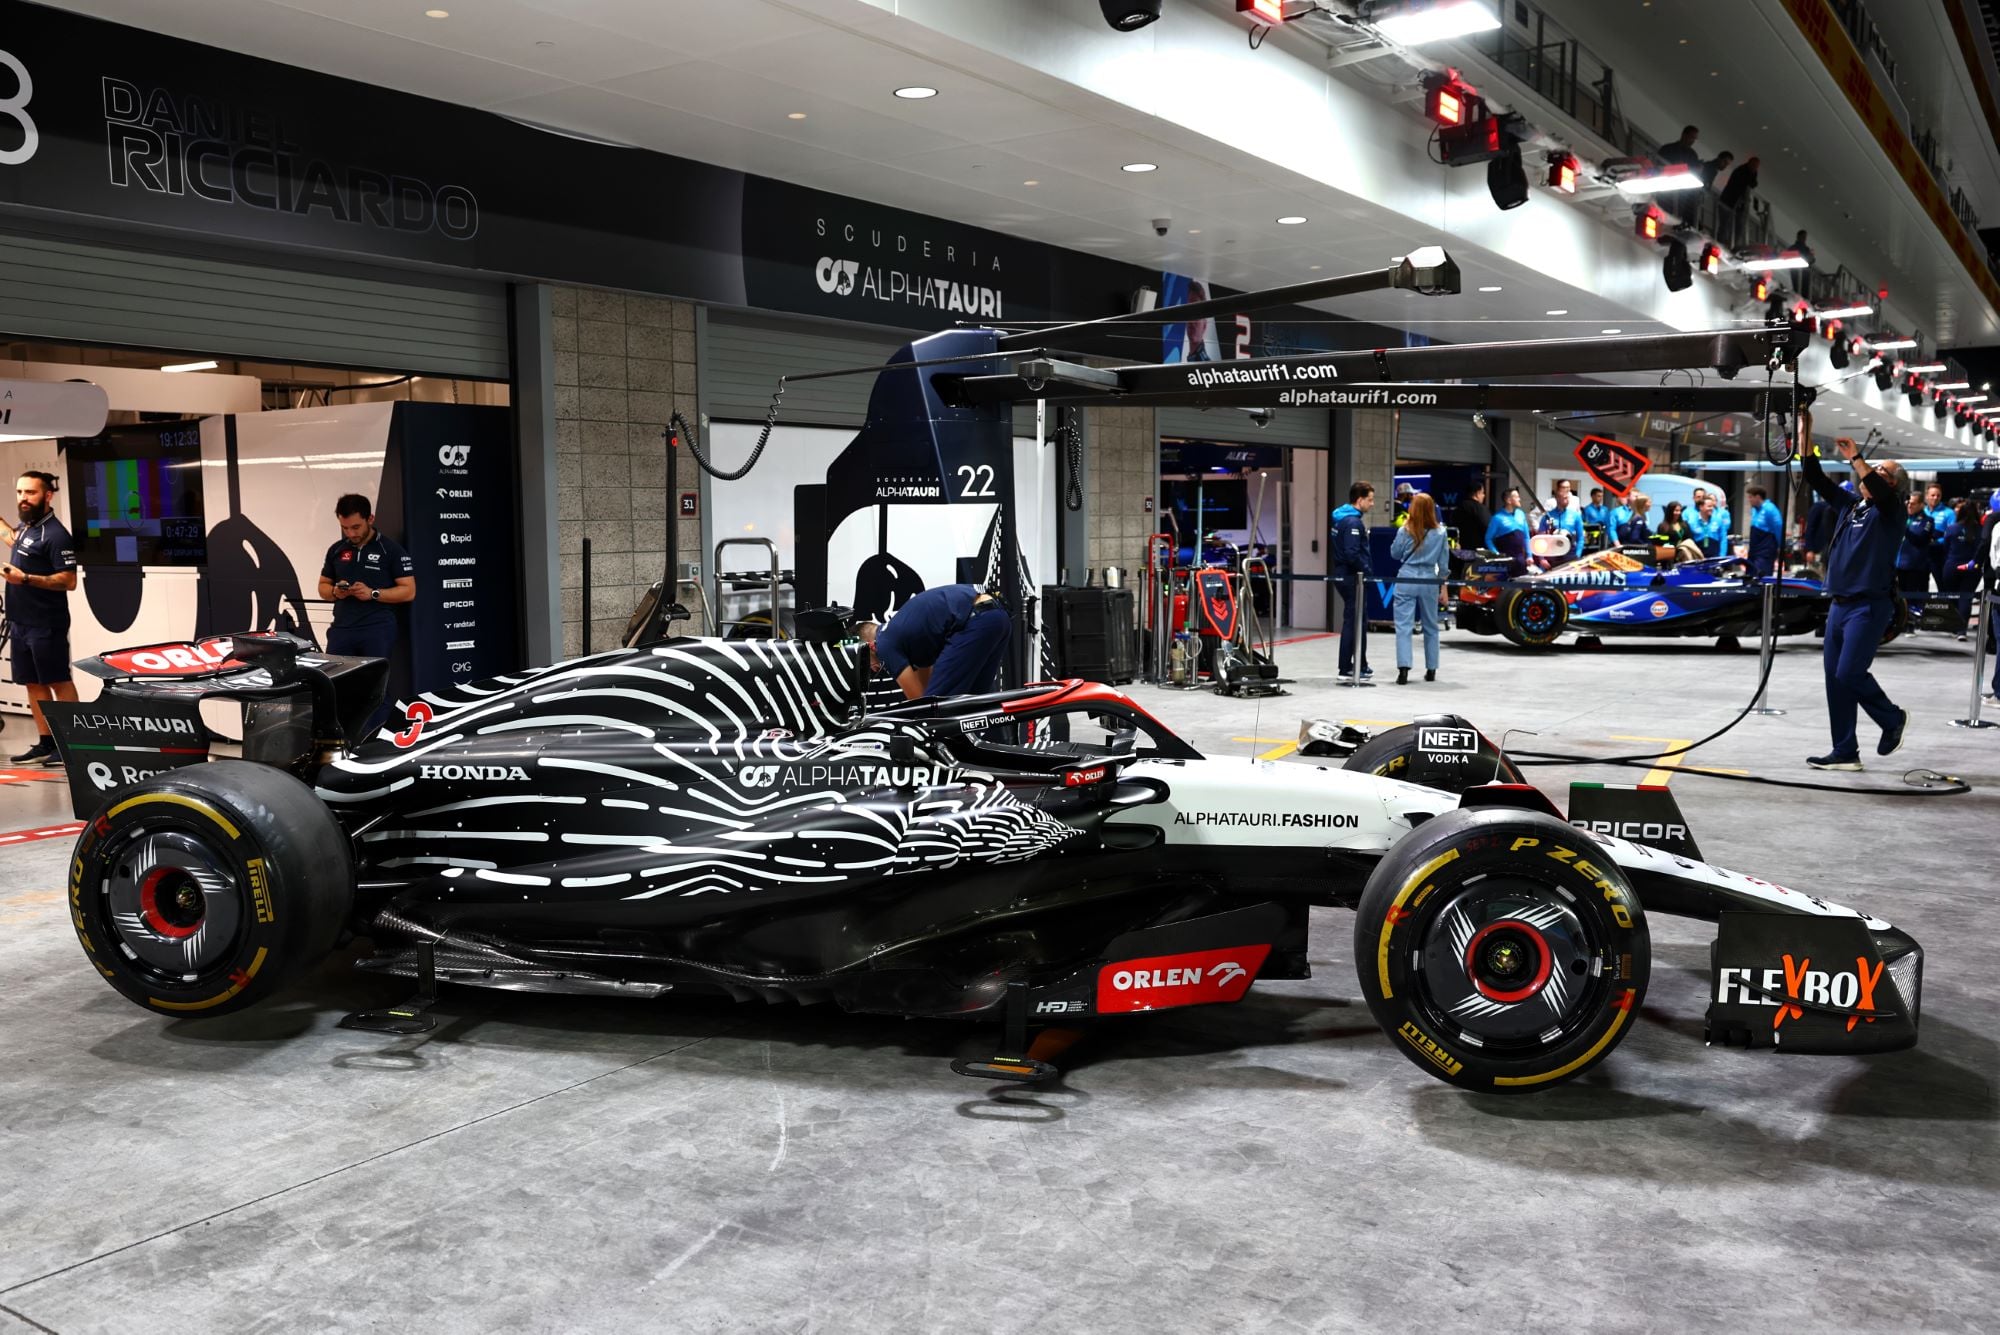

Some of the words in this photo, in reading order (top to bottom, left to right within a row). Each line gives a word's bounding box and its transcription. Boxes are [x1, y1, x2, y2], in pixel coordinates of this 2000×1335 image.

[107, 121, 479, 240] RICCIARDO
[818, 218, 1001, 271] SCUDERIA
[862, 267, 1001, 318] ALPHATAURI
[1187, 362, 1338, 387] alphataurif1.com
[1279, 388, 1437, 405] alphataurif1.com
[160, 431, 199, 447] 19:12:32
[957, 464, 996, 497] 22
[449, 490, 473, 498] ORLEN
[875, 486, 940, 497] ALPHATAURI
[683, 499, 694, 509] 31
[450, 534, 472, 543] Rapid
[443, 578, 473, 589] PIRELLI
[454, 620, 476, 628] randstad
[131, 637, 234, 670] ORLE
[73, 712, 195, 734] ALPHATAURI
[963, 720, 986, 730] NEFT
[989, 715, 1016, 725] VODKA
[1424, 732, 1472, 747] NEFT
[1427, 754, 1469, 764] VODKA
[419, 765, 532, 781] HONDA
[782, 765, 940, 787] ALPHATAURI
[1085, 770, 1105, 781] ORLEN
[1173, 811, 1359, 829] ALPHATAURI.FASHION
[247, 857, 274, 924] PIRELLI
[1510, 836, 1540, 852] P
[1546, 843, 1635, 929] ZERO
[1112, 967, 1203, 991] ORLEN
[1718, 953, 1884, 1032] FLEXBOX
[1398, 1020, 1463, 1077] PIRELLI
